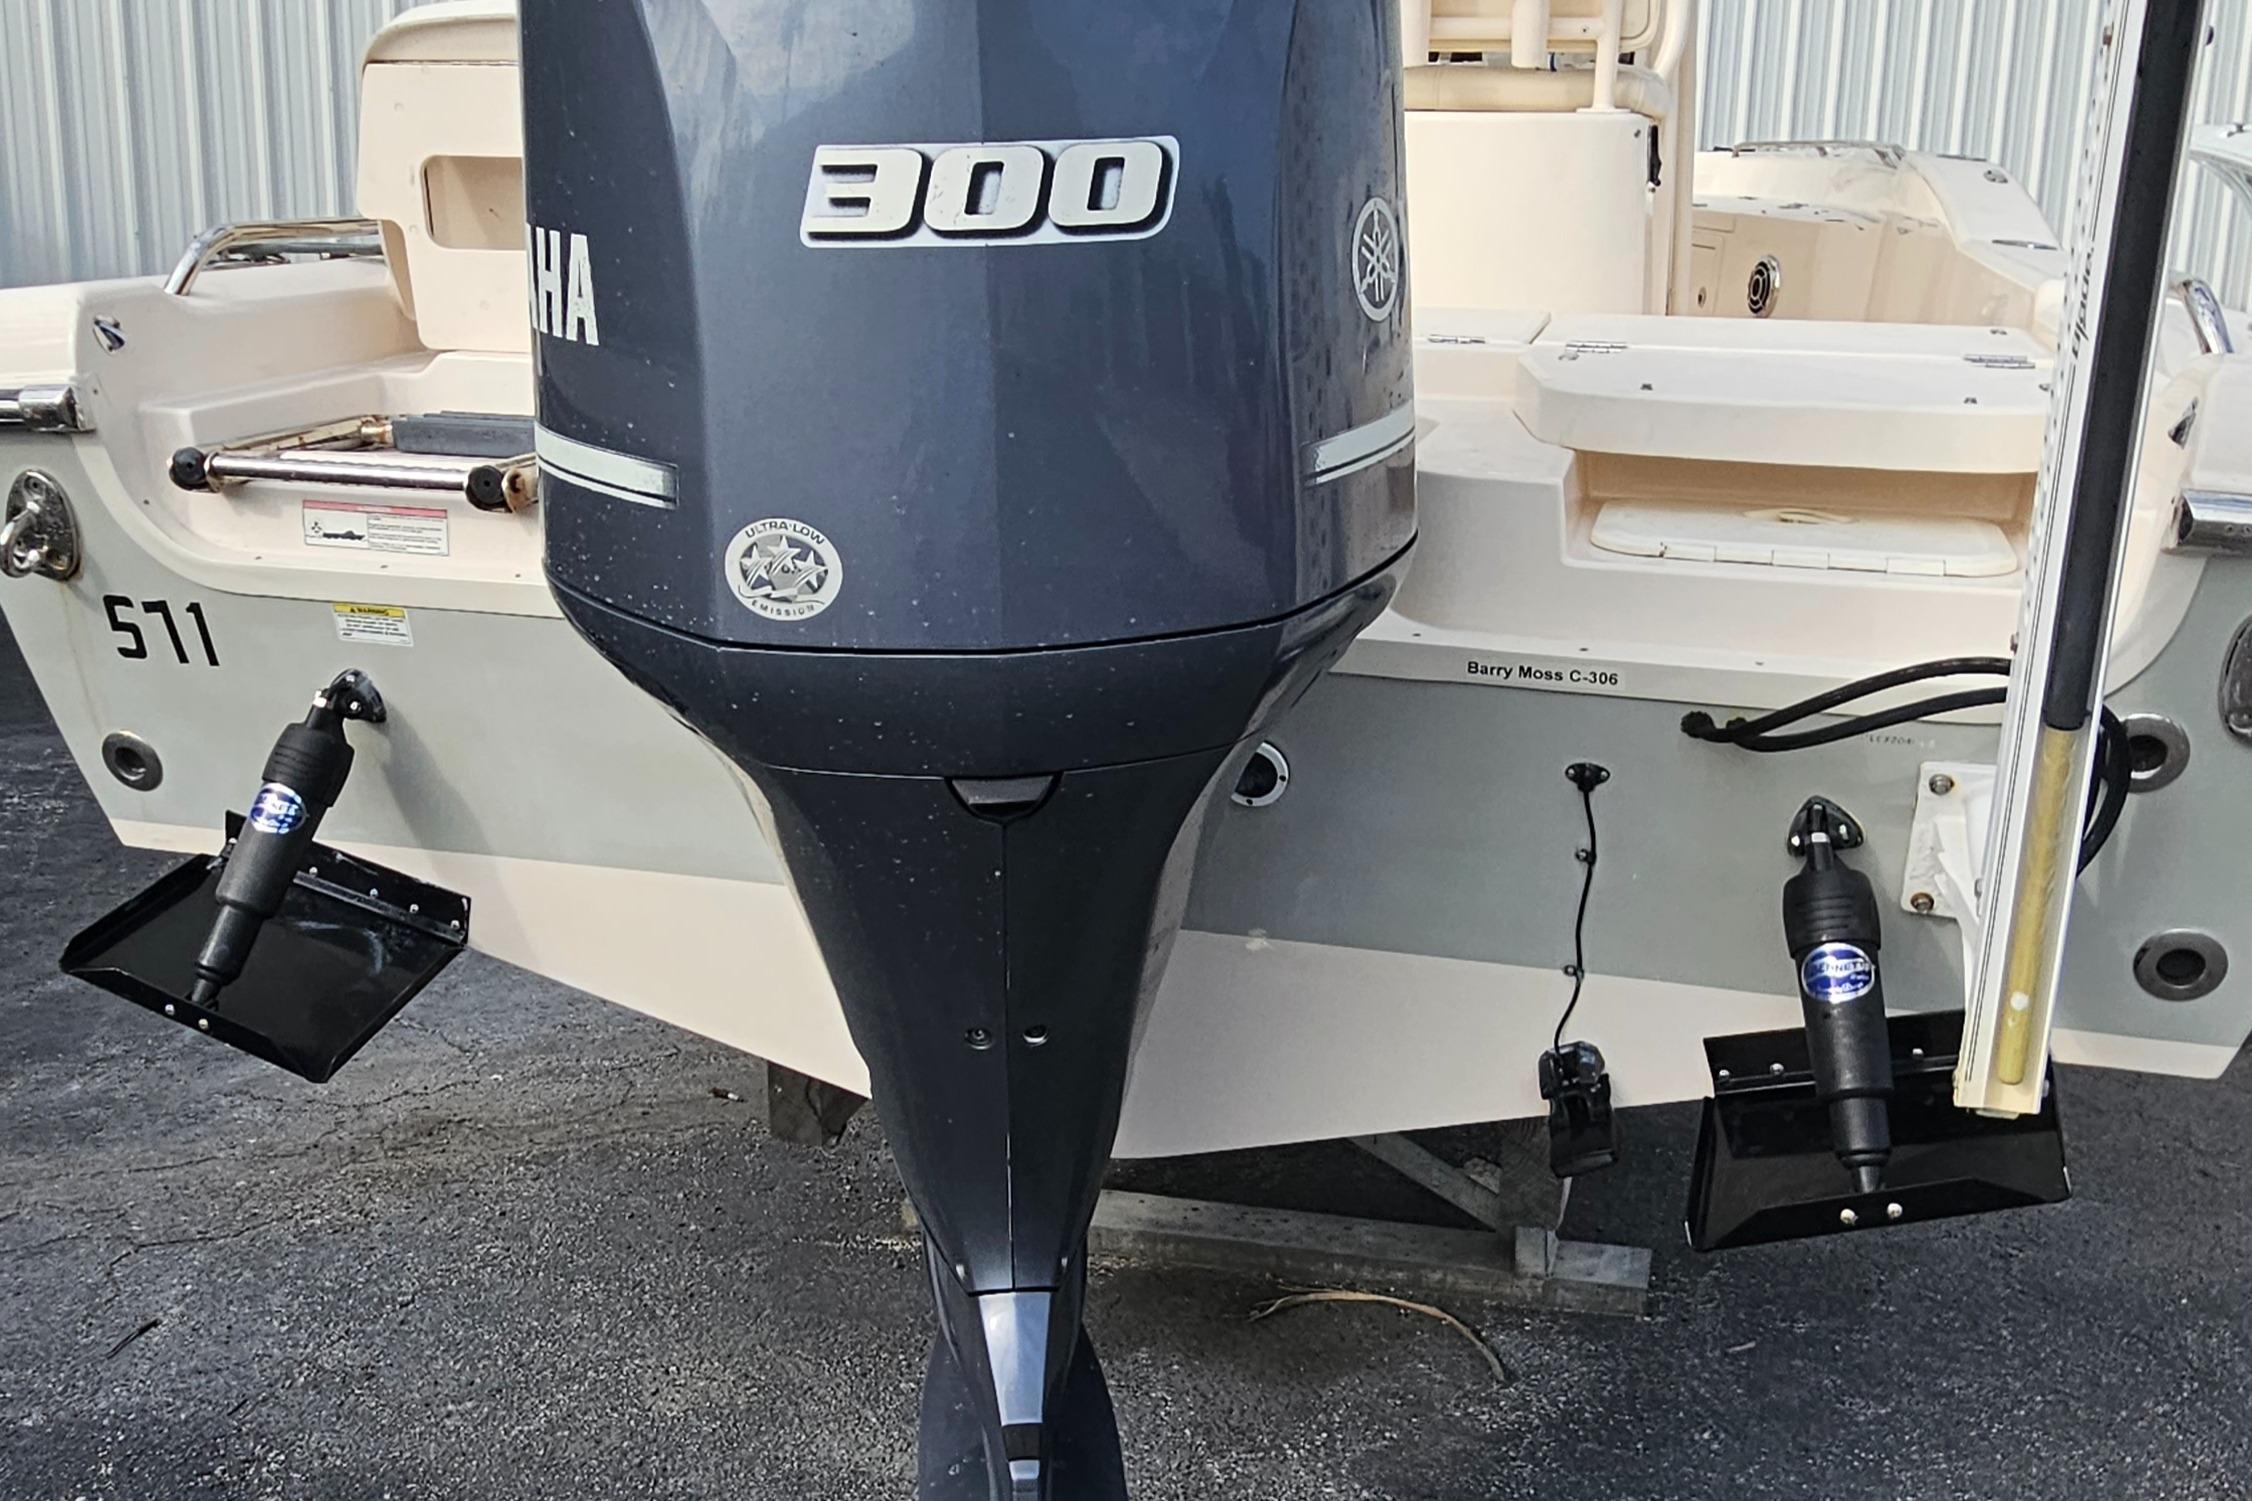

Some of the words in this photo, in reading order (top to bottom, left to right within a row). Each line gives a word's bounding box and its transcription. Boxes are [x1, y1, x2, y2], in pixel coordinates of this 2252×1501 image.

[805, 138, 1176, 243] 300
[102, 594, 220, 667] 571
[751, 600, 815, 617] EMISSION
[1467, 661, 1513, 680] Barry
[1518, 665, 1563, 681] Moss
[1569, 669, 1618, 686] C-306
